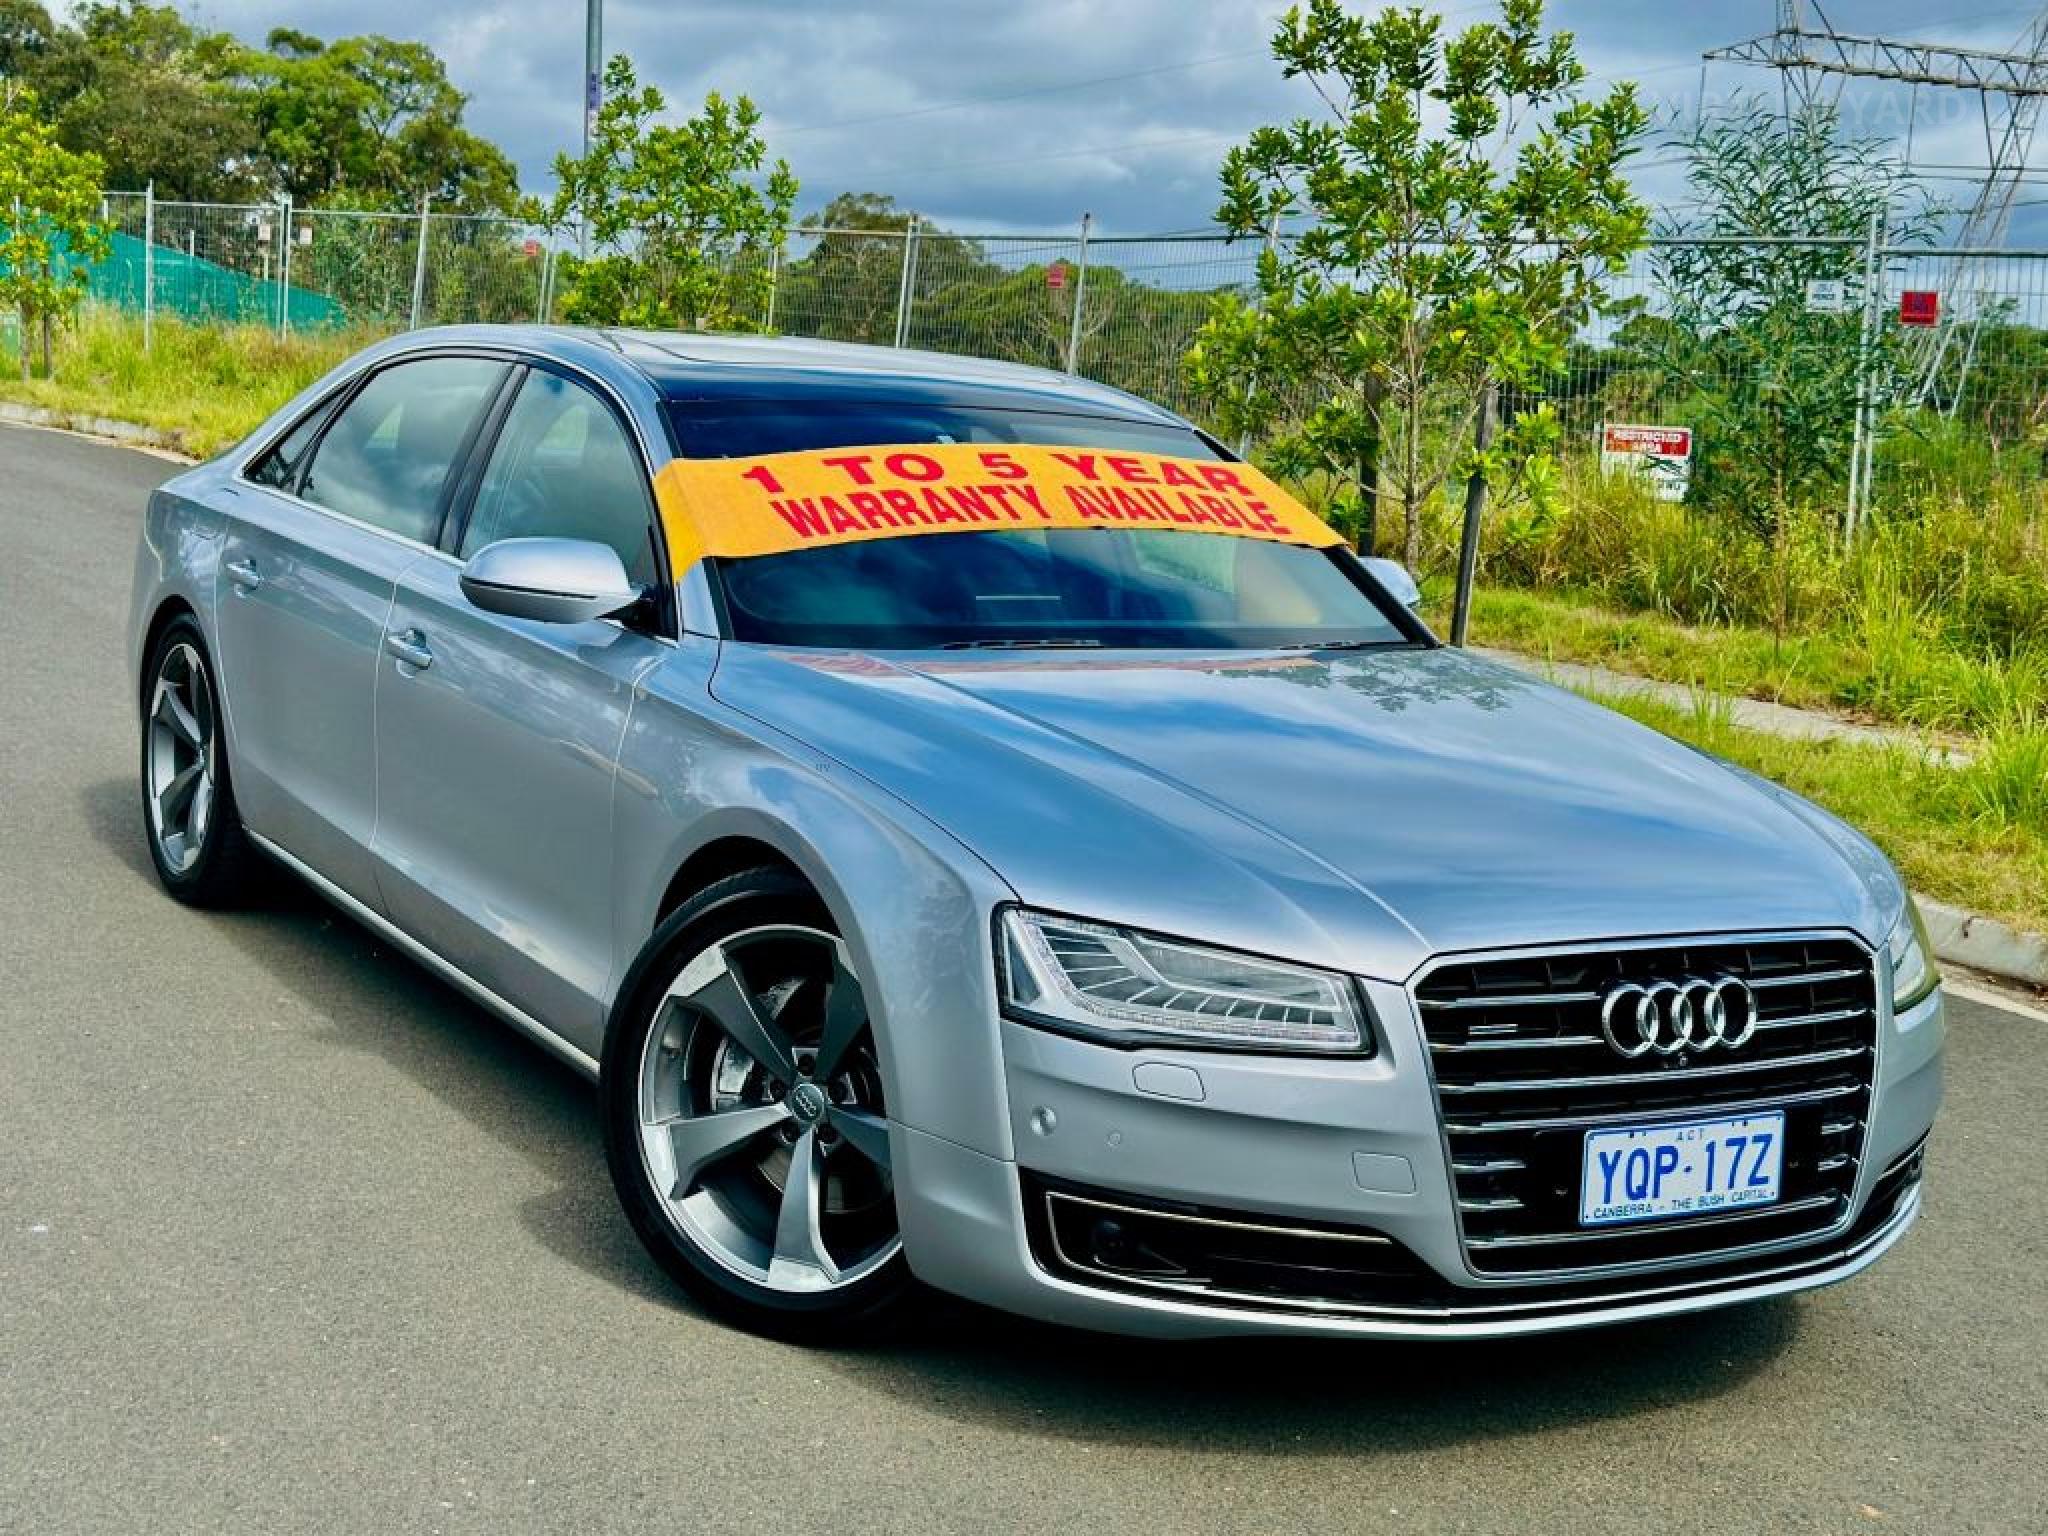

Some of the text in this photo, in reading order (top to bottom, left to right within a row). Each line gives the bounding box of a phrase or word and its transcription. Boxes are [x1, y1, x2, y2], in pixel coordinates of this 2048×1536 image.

[740, 453, 1256, 497] 1 TO 5 YEAR
[769, 484, 1291, 539] WARRANTY AVAILABLE
[1594, 1203, 1653, 1219] CANBERRA
[1672, 1198, 1692, 1210] THE
[1698, 1194, 1725, 1207] BUSH
